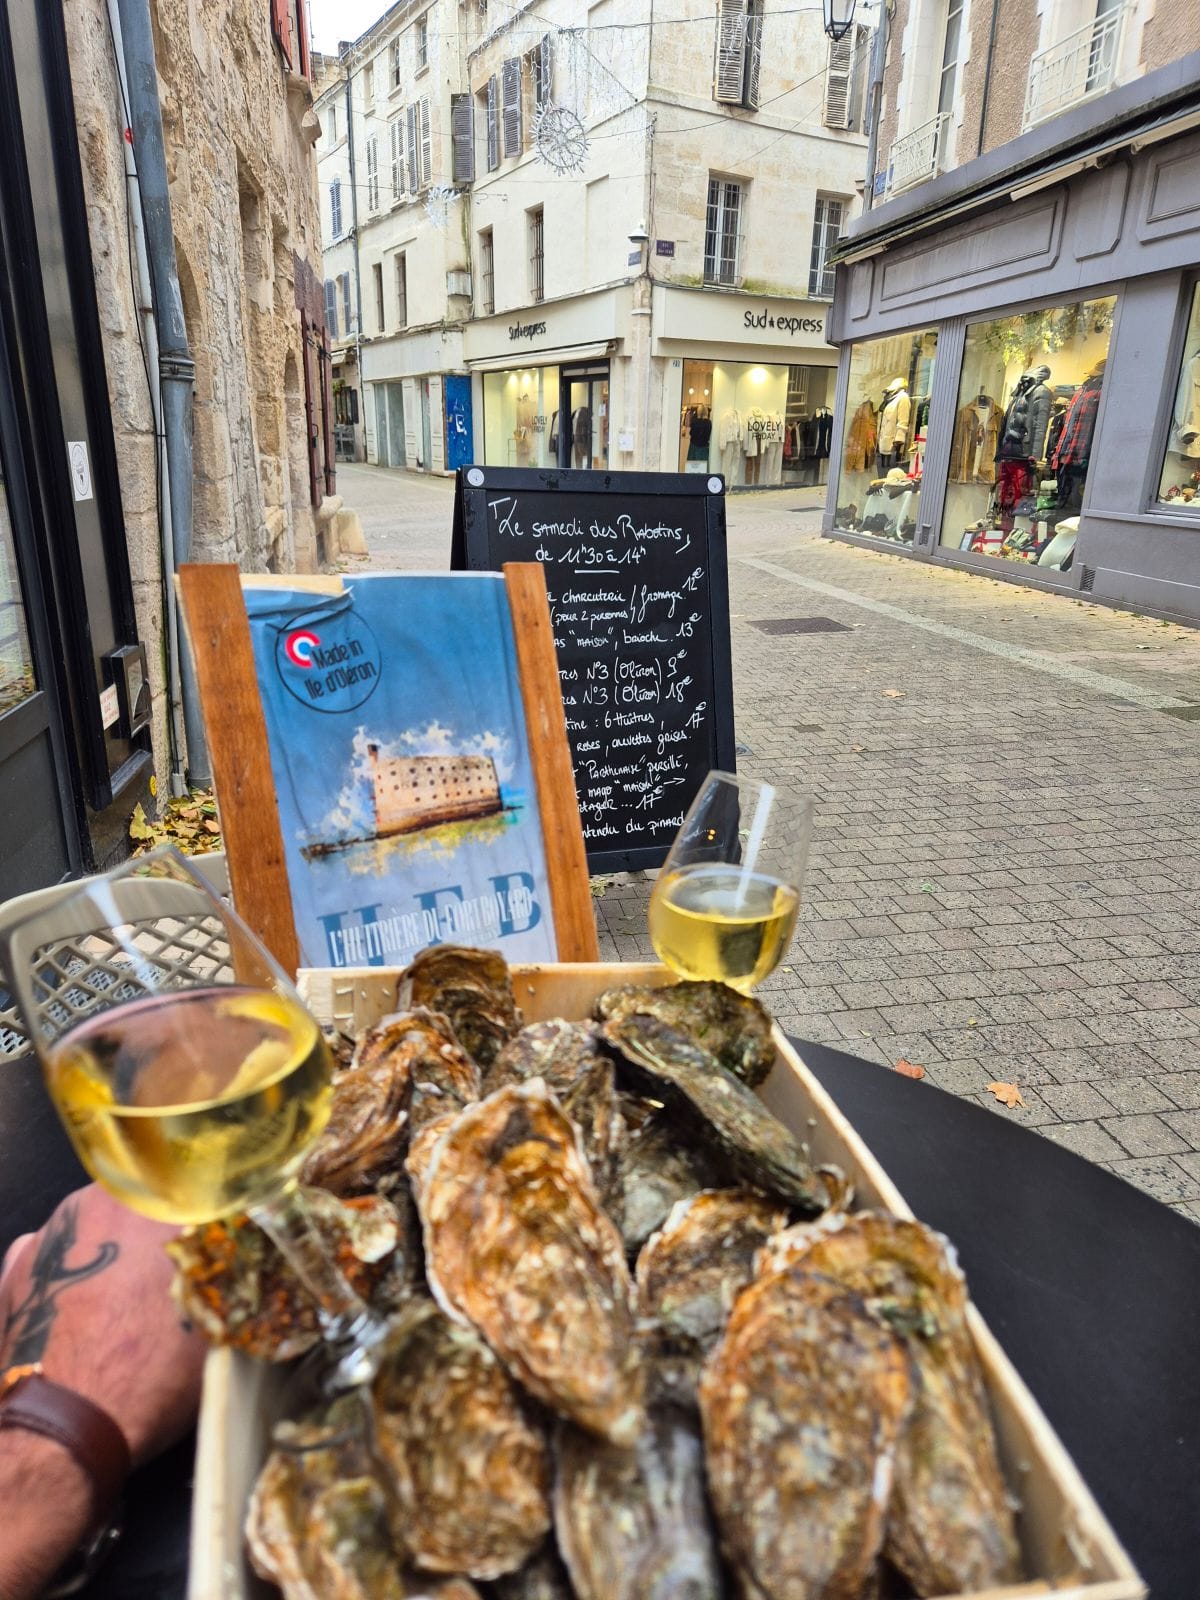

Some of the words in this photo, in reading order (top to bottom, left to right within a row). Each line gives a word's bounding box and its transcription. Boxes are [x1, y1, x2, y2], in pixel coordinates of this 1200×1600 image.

[743, 307, 768, 329] Sud
[776, 316, 823, 336] express
[747, 420, 782, 432] LOVELY
[589, 519, 618, 539] des
[535, 543, 553, 561] de
[580, 610, 589, 621] 2
[311, 641, 350, 671] Made
[345, 636, 364, 657] in
[604, 710, 612, 729] 6
[625, 818, 645, 834] du
